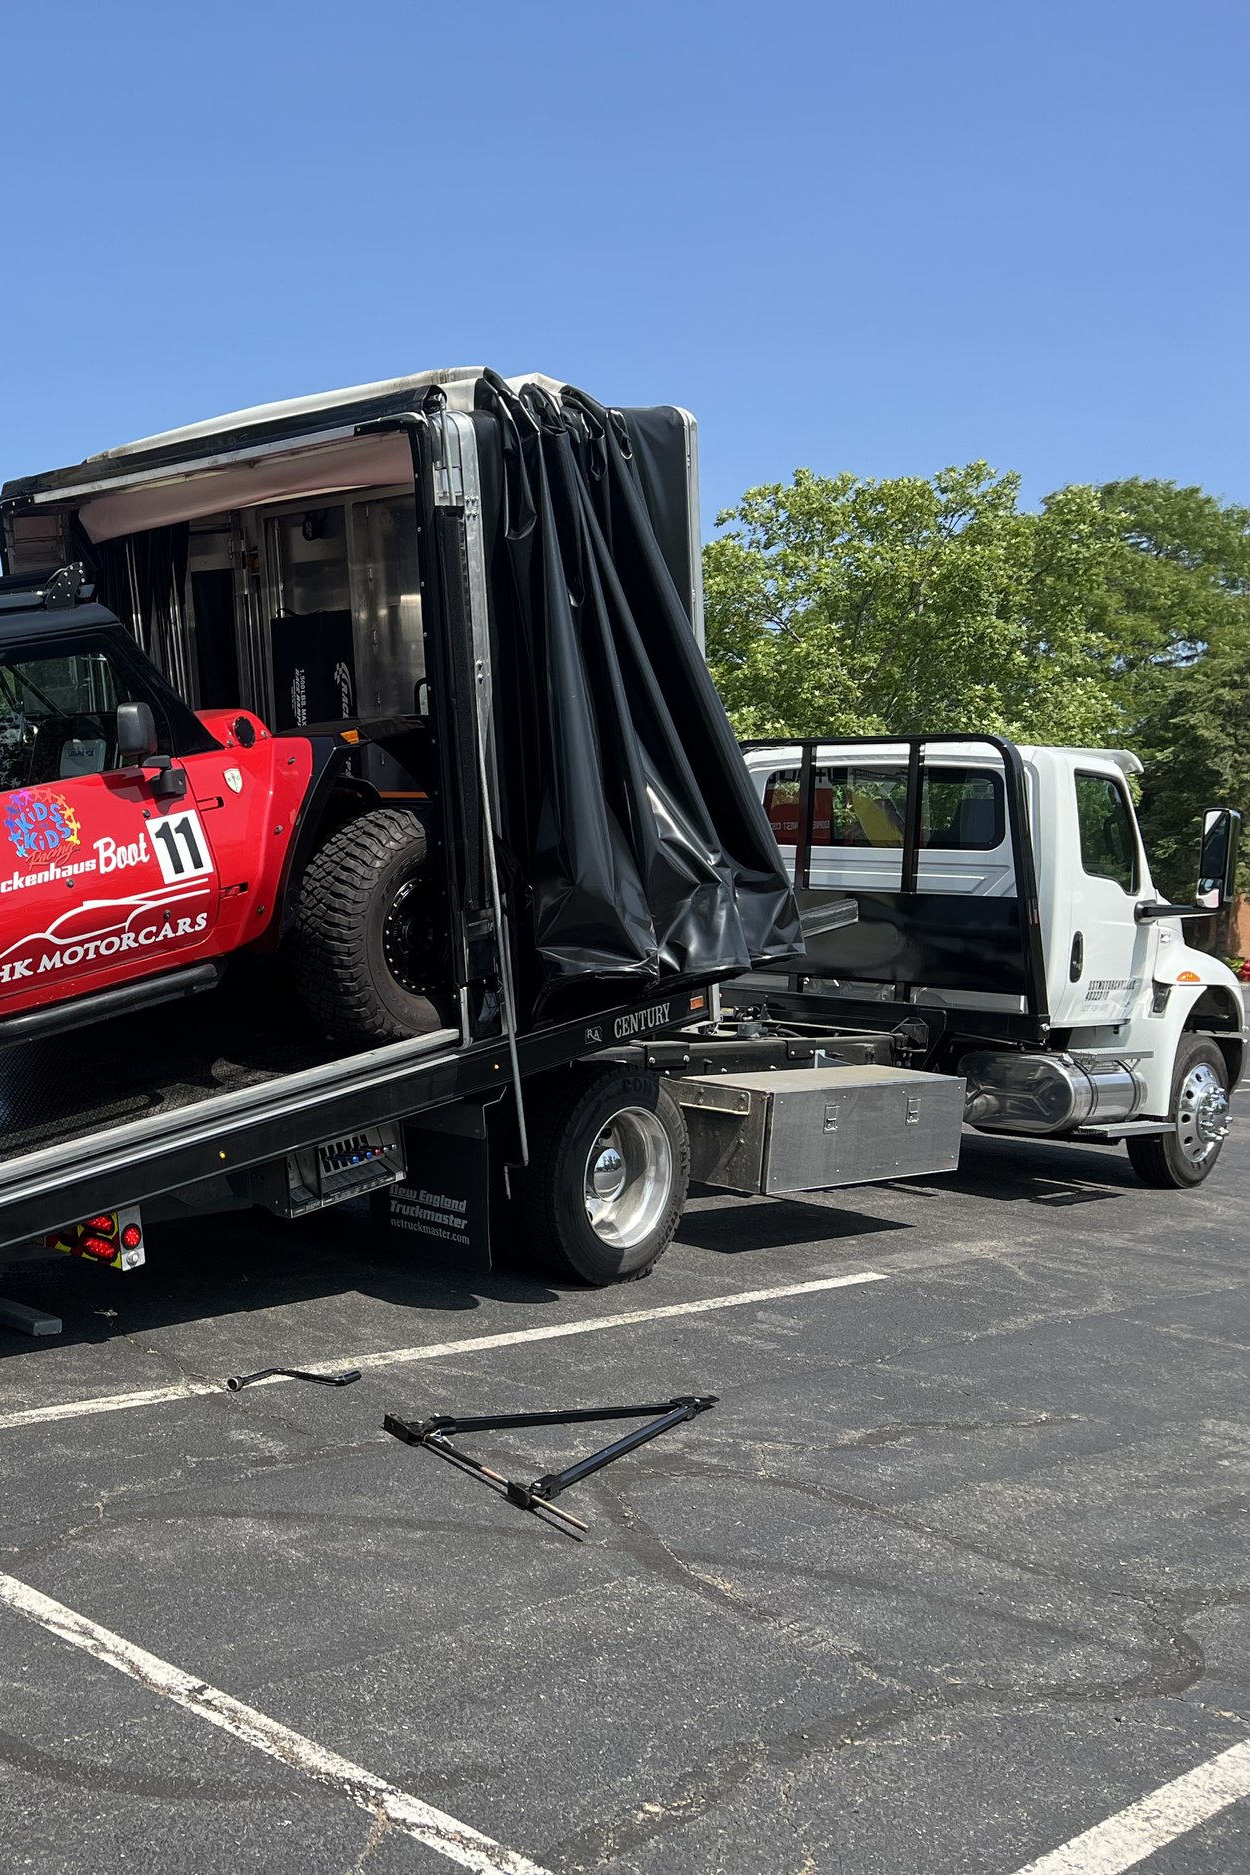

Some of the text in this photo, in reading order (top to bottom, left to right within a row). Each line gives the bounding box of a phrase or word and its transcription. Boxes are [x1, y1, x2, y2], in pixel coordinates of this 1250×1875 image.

[93, 832, 150, 874] Boot
[155, 816, 204, 875] 11
[36, 912, 208, 974] MOTORCARS
[614, 1002, 670, 1038] CENTURY
[390, 1184, 418, 1199] New
[418, 1190, 467, 1211] England
[390, 1200, 468, 1230] Truckmaster
[390, 1218, 470, 1244] netruckmaster.com
